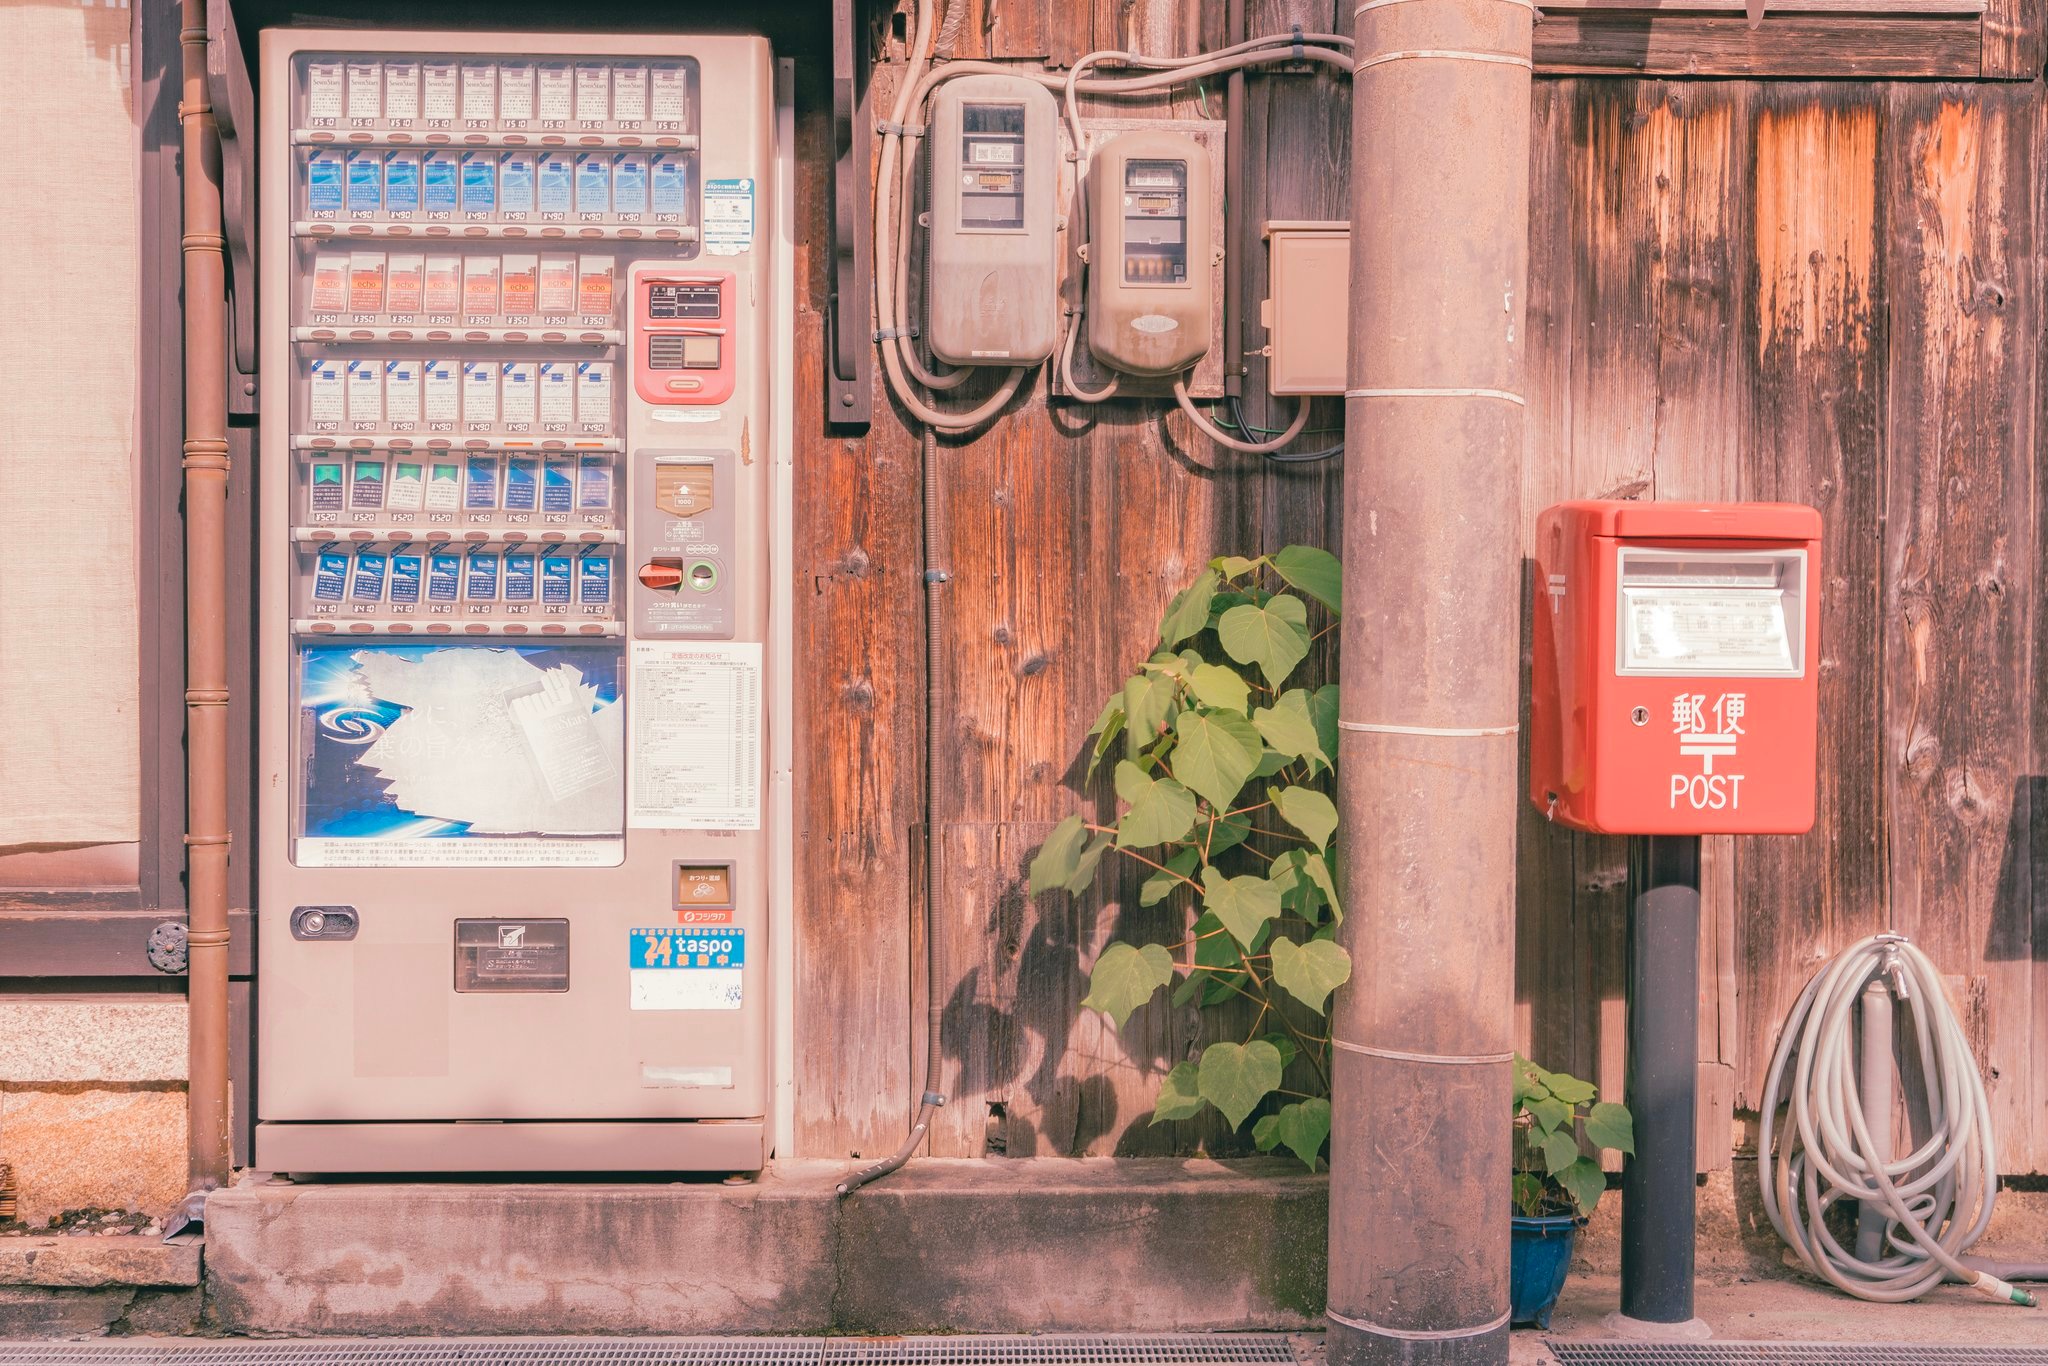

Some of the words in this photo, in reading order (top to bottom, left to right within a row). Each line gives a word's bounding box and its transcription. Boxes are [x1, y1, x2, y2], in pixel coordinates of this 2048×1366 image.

[1672, 692, 1745, 734] 郵便
[1670, 774, 1745, 809] POST
[676, 938, 732, 956] taspo
